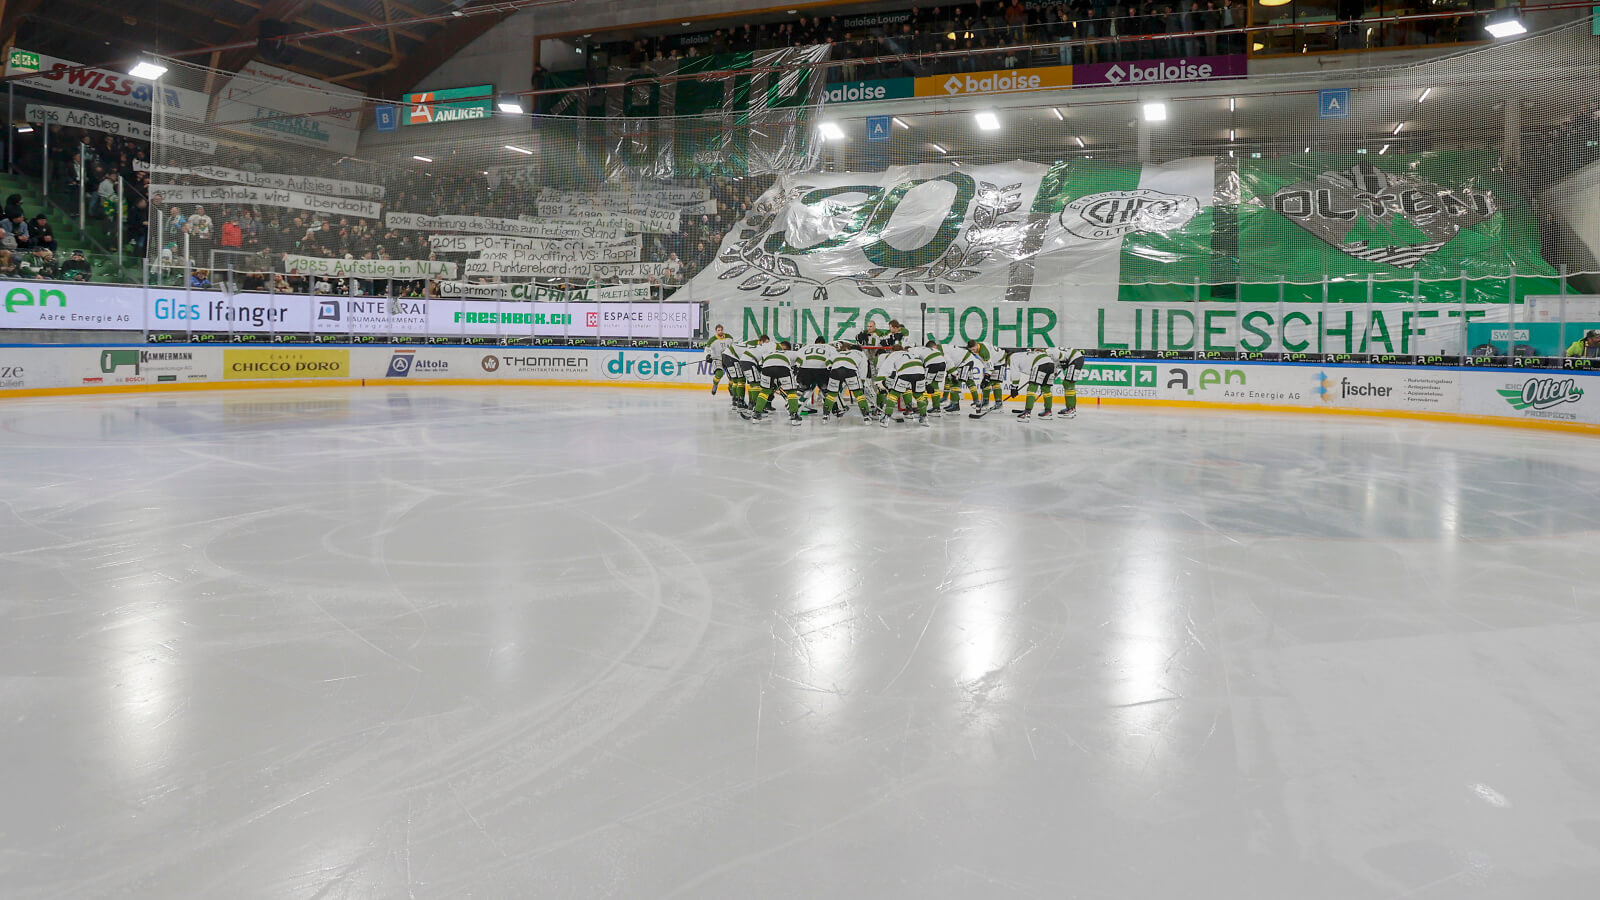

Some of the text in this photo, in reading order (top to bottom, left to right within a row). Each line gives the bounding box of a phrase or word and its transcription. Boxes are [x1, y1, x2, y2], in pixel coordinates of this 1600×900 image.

[843, 16, 876, 28] Baloise
[1129, 58, 1213, 83] baloise
[965, 70, 1041, 93] baloise
[1328, 98, 1340, 109] A
[382, 113, 389, 123] B
[434, 103, 485, 122] ANLIKER
[66, 110, 120, 134] Aufstieg
[127, 123, 140, 135] in
[873, 123, 883, 135] A
[265, 190, 290, 202] wird
[1272, 187, 1498, 220] OLTEN
[583, 226, 617, 240] Stand
[1093, 224, 1140, 238] OLTE
[433, 237, 467, 250] 2015
[603, 246, 637, 260] Rappi
[289, 258, 449, 276] 1985 Aufstieg in NLA
[40, 313, 130, 324] Aare Energie AG
[154, 297, 288, 327] Glas Ifanger
[604, 312, 688, 322] ESPACE BROKER
[1493, 331, 1528, 340] SWCA
[140, 350, 193, 363] KAMMERMANN
[502, 356, 589, 367] THOMMEN
[232, 361, 341, 372] CHICCO D'ORO
[415, 359, 449, 368] Altola
[607, 351, 688, 376] dreier
[1077, 369, 1128, 382] PARK
[1340, 376, 1393, 399] fischer
[1522, 377, 1575, 405] Olten
[1224, 390, 1301, 401] Aare Energie AG
